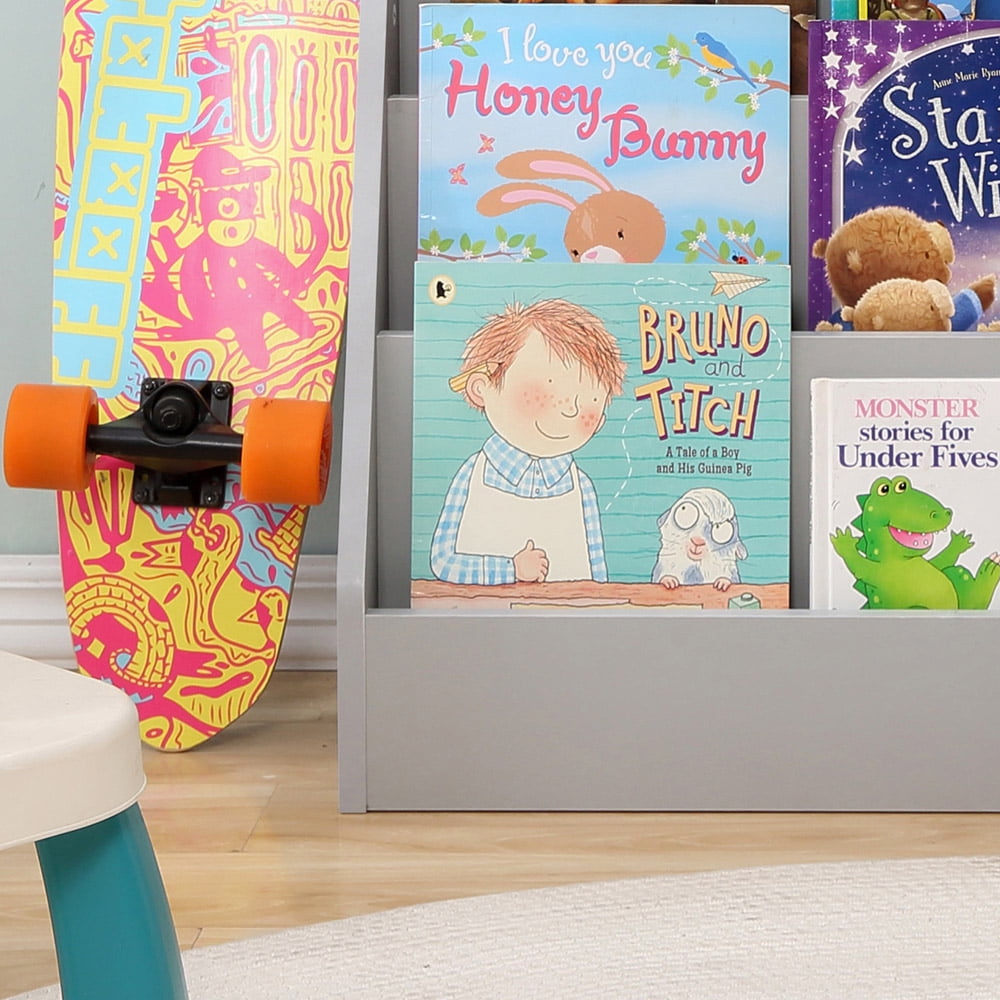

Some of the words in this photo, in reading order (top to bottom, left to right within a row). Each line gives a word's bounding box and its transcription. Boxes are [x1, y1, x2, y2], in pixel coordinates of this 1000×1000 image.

[497, 26, 513, 65] I
[523, 22, 589, 67] love
[595, 40, 653, 80] you
[932, 78, 953, 90] Anne
[954, 71, 979, 83] Marie
[444, 59, 602, 140] Honey
[601, 103, 767, 185] Bunny
[638, 303, 771, 375] BRUNO
[704, 353, 746, 378] and
[634, 378, 761, 441] TITCH
[854, 398, 980, 418] MONSTER
[859, 421, 933, 442] stories
[939, 421, 975, 442] for
[666, 446, 673, 457] A
[676, 446, 697, 457] Tale
[699, 446, 710, 457] of
[712, 449, 718, 457] a
[721, 446, 740, 460] Boy
[838, 445, 924, 468] Under
[930, 445, 999, 468] Fives
[656, 463, 674, 473] and
[678, 463, 695, 473] His
[698, 463, 733, 473] Guinea
[736, 463, 752, 477] Pig
